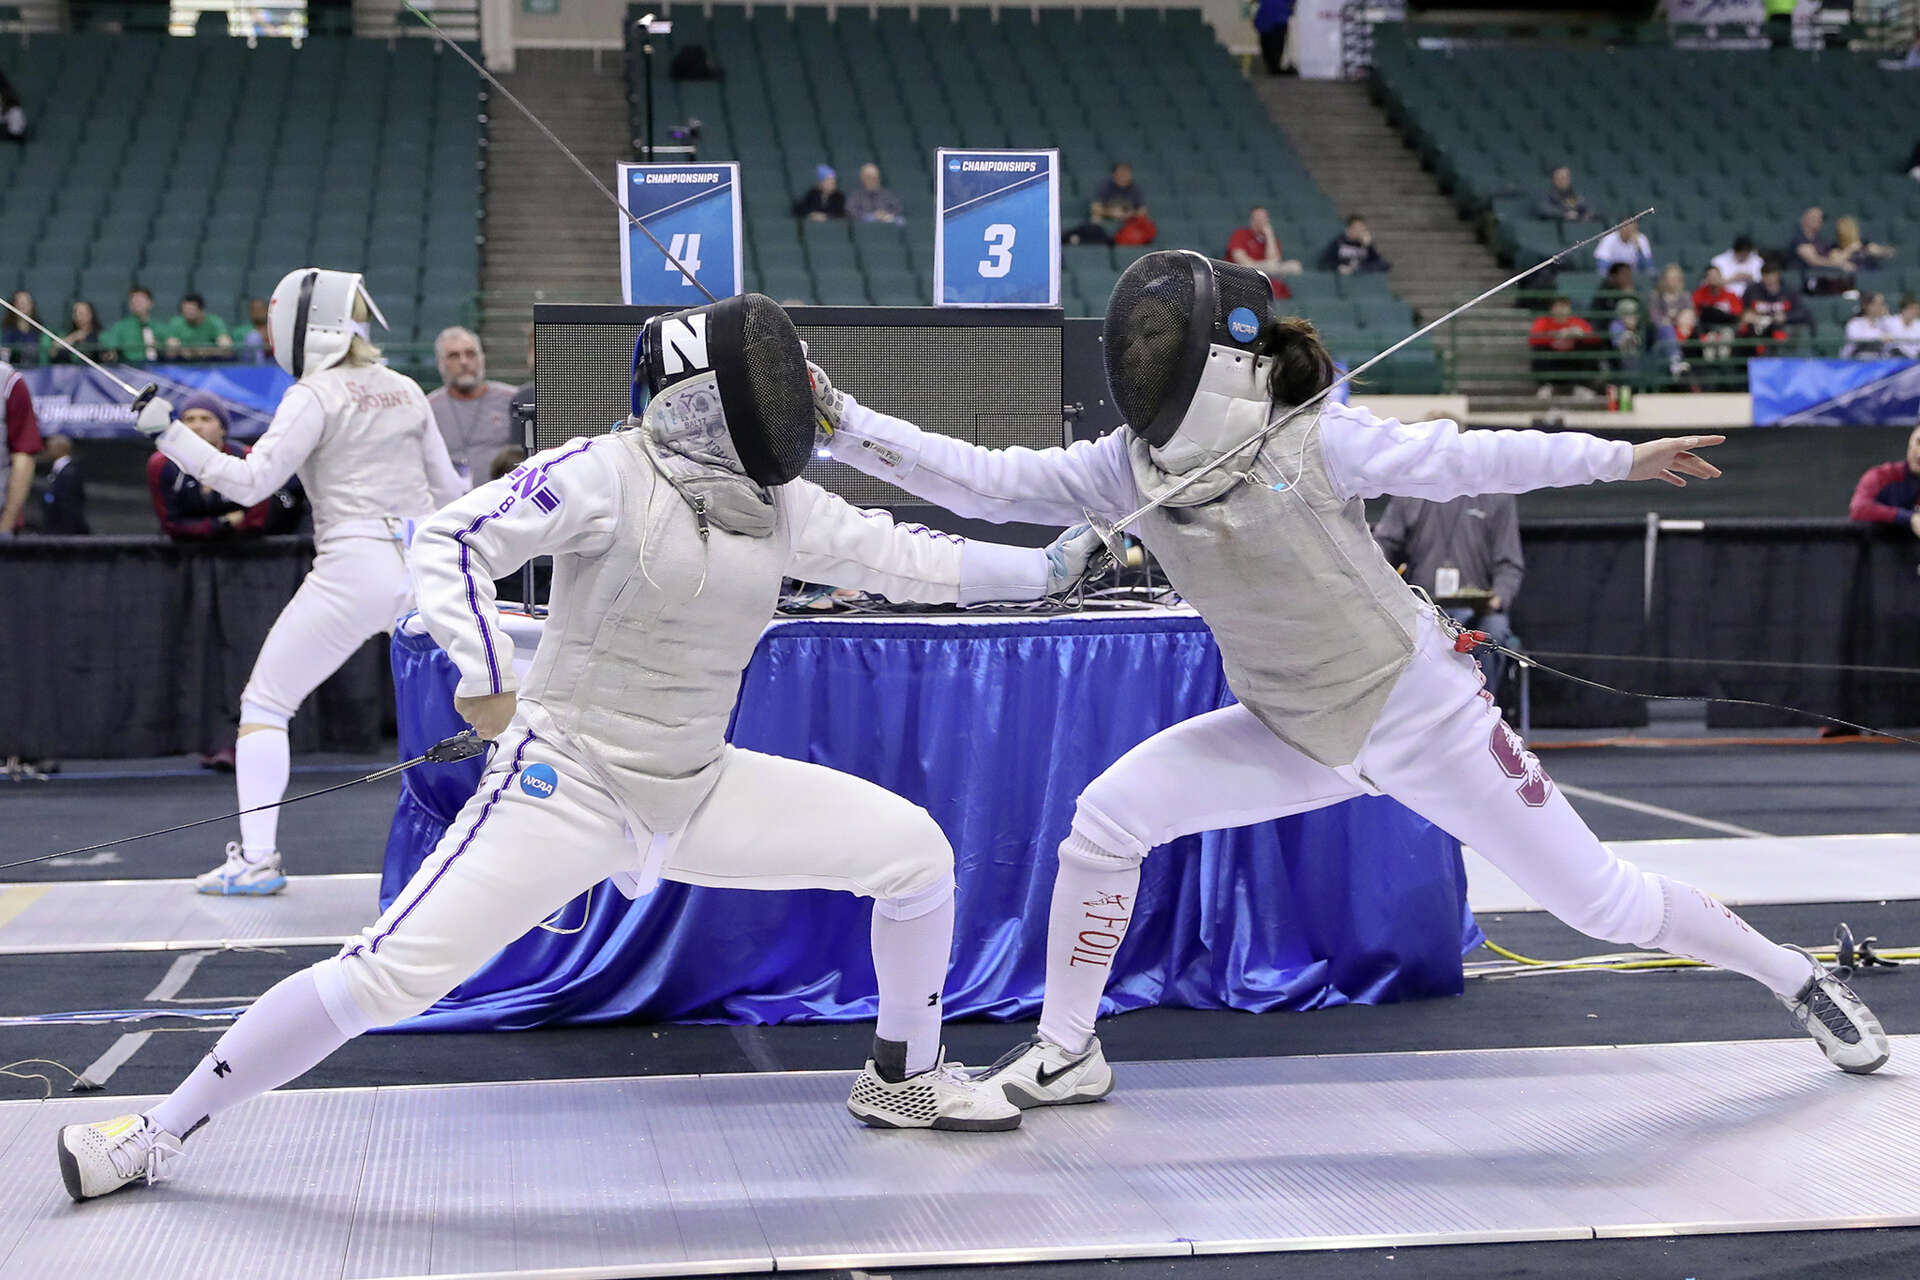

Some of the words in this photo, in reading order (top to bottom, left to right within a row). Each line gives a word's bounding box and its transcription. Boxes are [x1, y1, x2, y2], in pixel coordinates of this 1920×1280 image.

[645, 173, 719, 184] CHAMPIONSHIPS
[962, 161, 1037, 172] CHAMPIONSHIPS
[664, 233, 701, 286] 4
[977, 223, 1017, 278] 3
[661, 312, 709, 376] N
[1231, 321, 1257, 335] NCAA
[523, 774, 553, 795] NCAA
[1070, 911, 1129, 968] FOIL
